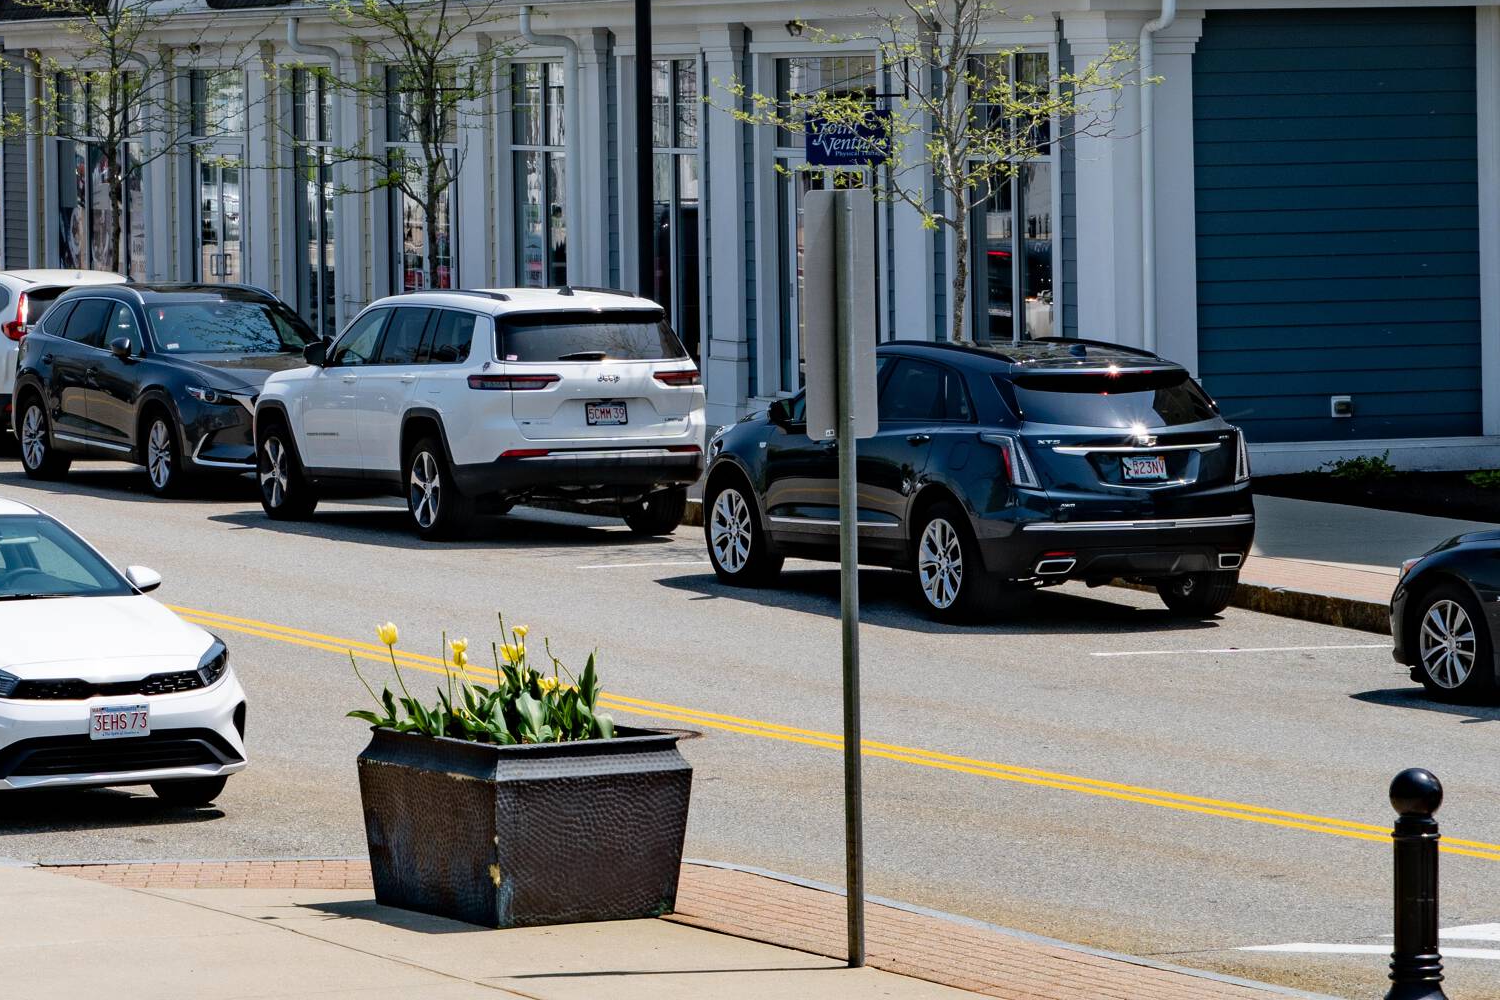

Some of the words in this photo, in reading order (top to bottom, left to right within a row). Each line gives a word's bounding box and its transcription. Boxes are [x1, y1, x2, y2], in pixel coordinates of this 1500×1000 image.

[597, 374, 620, 384] Jeep
[613, 406, 625, 419] 39
[94, 713, 127, 731] 3EHS
[131, 712, 147, 729] 73
